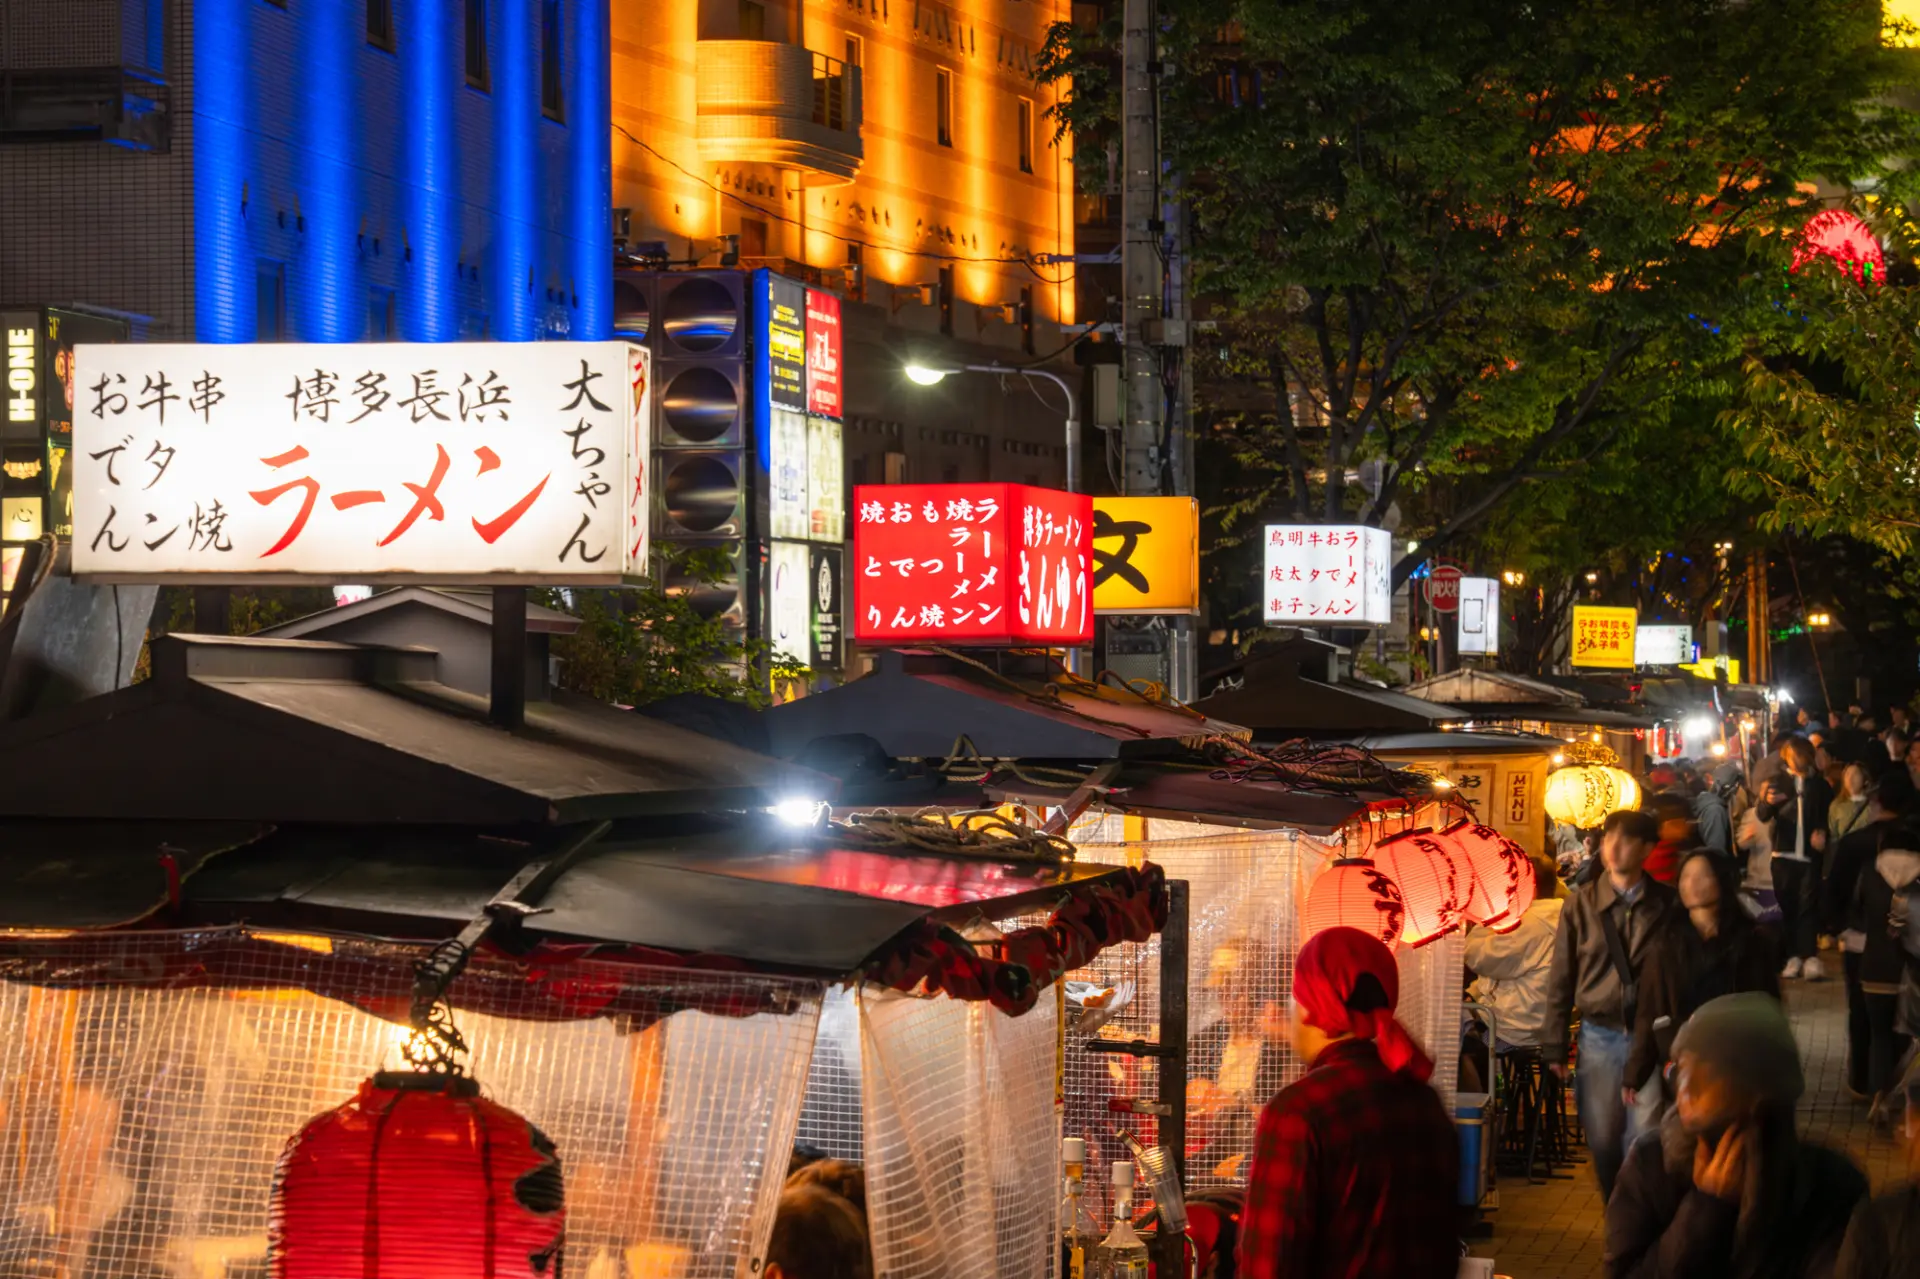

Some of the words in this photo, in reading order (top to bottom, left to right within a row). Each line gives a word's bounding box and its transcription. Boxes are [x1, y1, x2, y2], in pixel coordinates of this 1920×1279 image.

[8, 328, 36, 421] H-ONE
[285, 368, 512, 424] 博多長浜
[88, 373, 134, 552] おでん
[136, 371, 181, 552] 牛タン
[188, 370, 233, 552] 串焼
[248, 443, 552, 559] ラーメン
[558, 359, 613, 563] 大ちゃん
[631, 361, 646, 560] ラーメン
[860, 500, 886, 629] 焼とり
[890, 501, 916, 628] おでん
[920, 500, 946, 628] もつ焼
[945, 498, 975, 625] 焼ラーメン
[975, 498, 1002, 625] ラーメン
[1022, 505, 1083, 548] 博多ラーメン
[1288, 531, 1304, 614] 明太子
[1307, 531, 1323, 616] 牛タン
[1324, 531, 1341, 615] おでん
[1343, 531, 1359, 615] ラーメン
[1018, 550, 1087, 635] さんゆう
[1511, 774, 1527, 822] MENU
